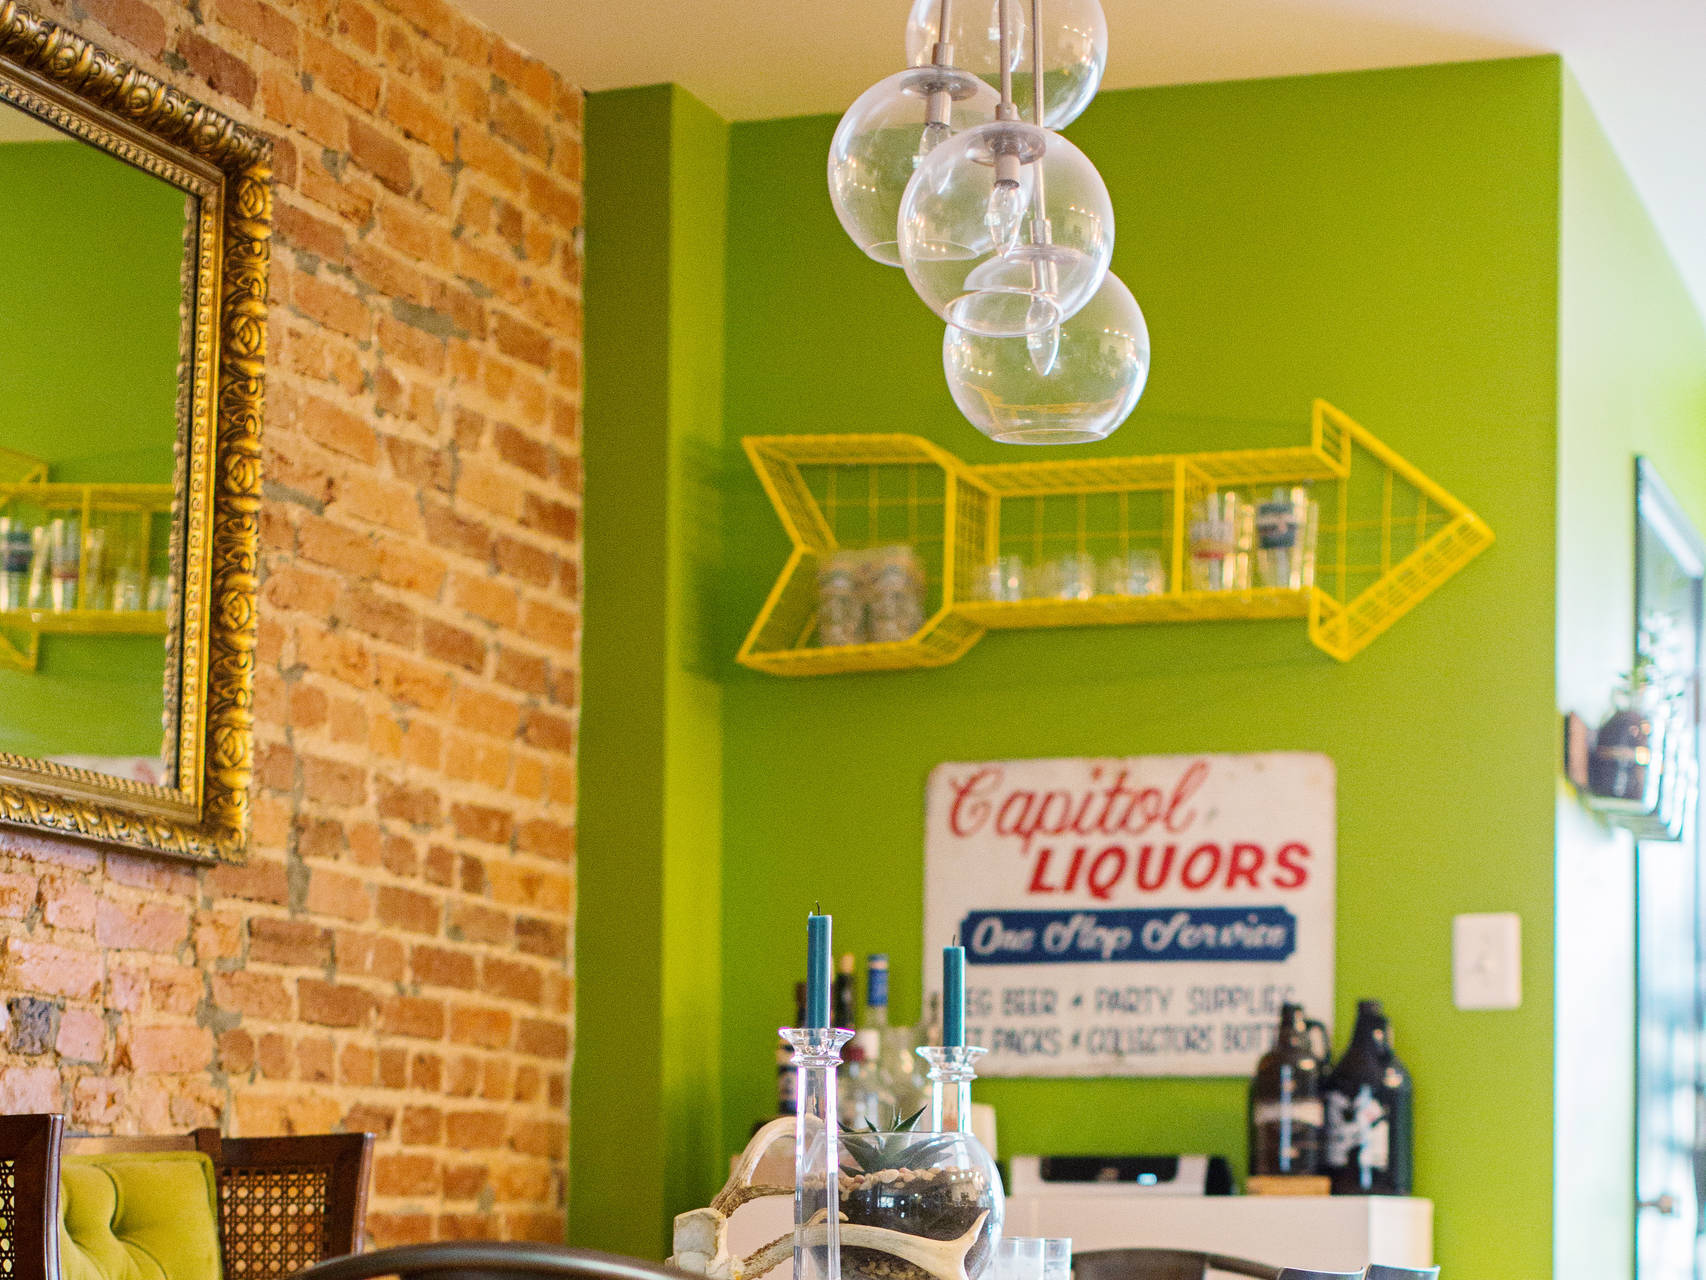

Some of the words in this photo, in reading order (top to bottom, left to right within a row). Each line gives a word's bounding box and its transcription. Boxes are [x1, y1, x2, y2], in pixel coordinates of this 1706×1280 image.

[948, 760, 1209, 856] Capitol
[1028, 841, 1312, 900] LIQUORS
[971, 916, 1035, 955] One
[1042, 913, 1132, 960] Stop
[1141, 912, 1287, 951] Service
[965, 986, 992, 1016] EG
[1002, 986, 1057, 1016] BEER
[1095, 985, 1173, 1014] PARTY
[992, 1027, 1062, 1056] PACKS
[1086, 1024, 1214, 1056] COLLECTORS
[1223, 1022, 1279, 1053] BOTT
